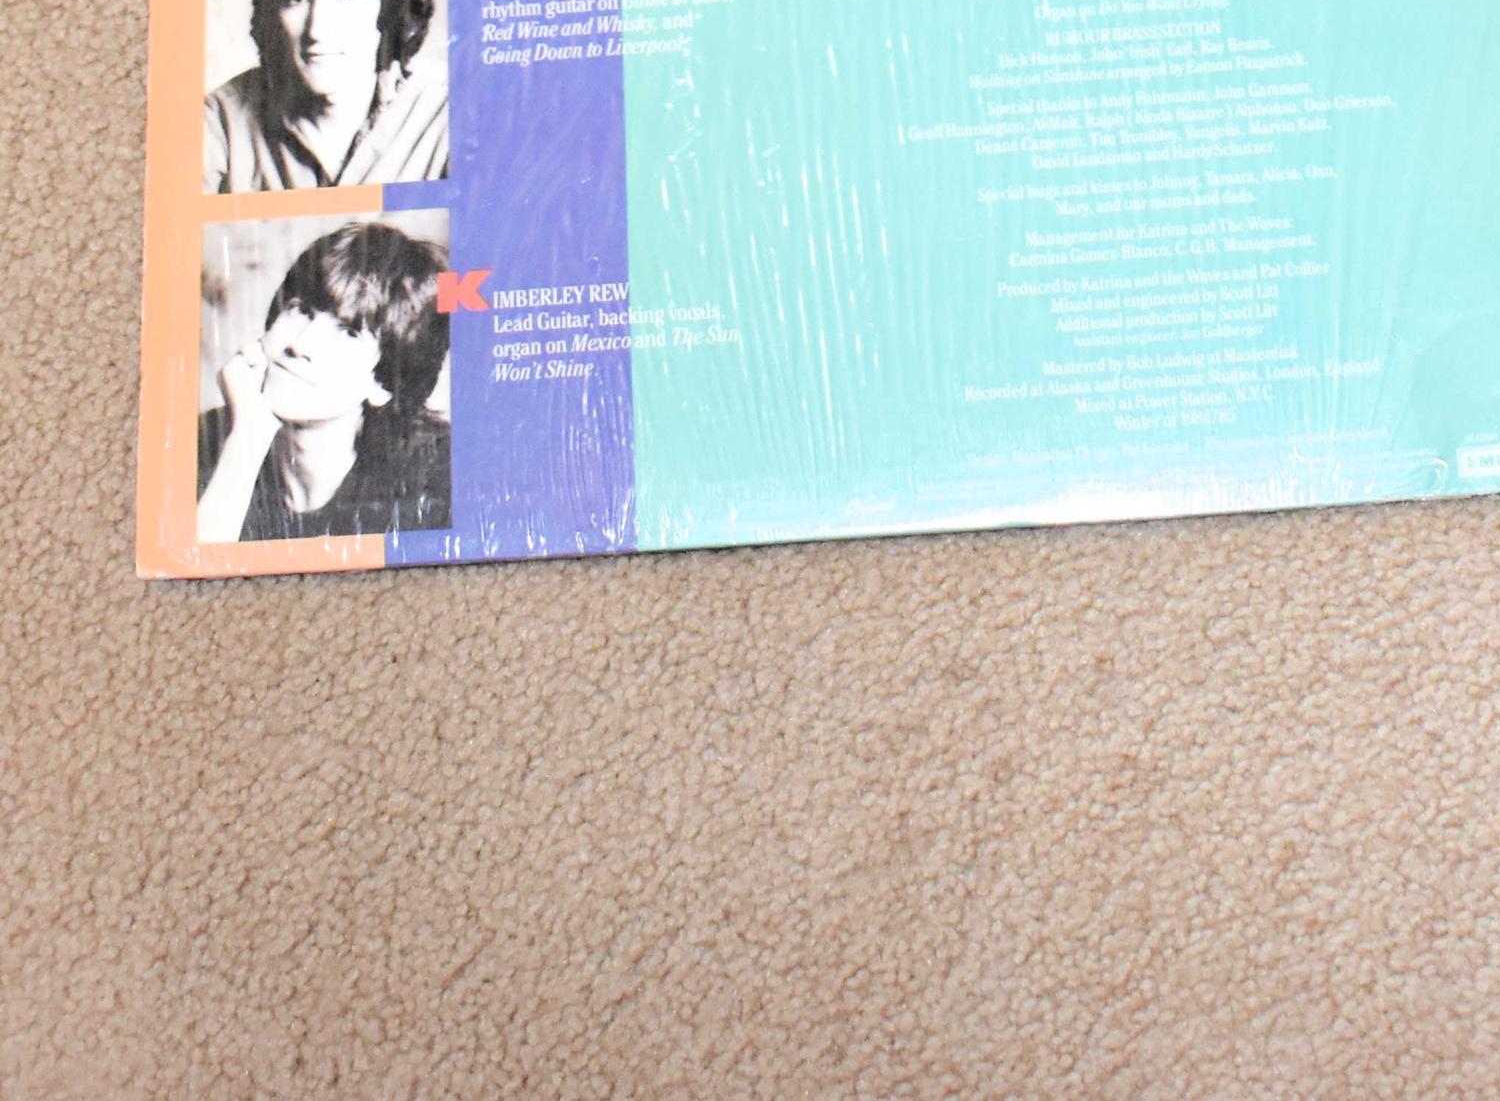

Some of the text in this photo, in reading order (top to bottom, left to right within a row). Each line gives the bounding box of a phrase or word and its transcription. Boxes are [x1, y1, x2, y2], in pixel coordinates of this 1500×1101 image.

[482, 23, 514, 41] Red
[517, 20, 558, 39] Wine
[560, 18, 592, 36] and
[663, 11, 693, 29] and
[482, 45, 530, 69] Going
[533, 41, 582, 61] Down
[585, 40, 602, 57] to
[589, 283, 630, 302] REW
[493, 313, 533, 332] Lead
[537, 310, 594, 331] Guitar,
[599, 305, 665, 330] backing
[493, 342, 541, 361] organ
[546, 340, 567, 352] on
[571, 332, 631, 351] Mexico
[635, 330, 666, 347] and
[494, 358, 599, 381] Won't Shine.
